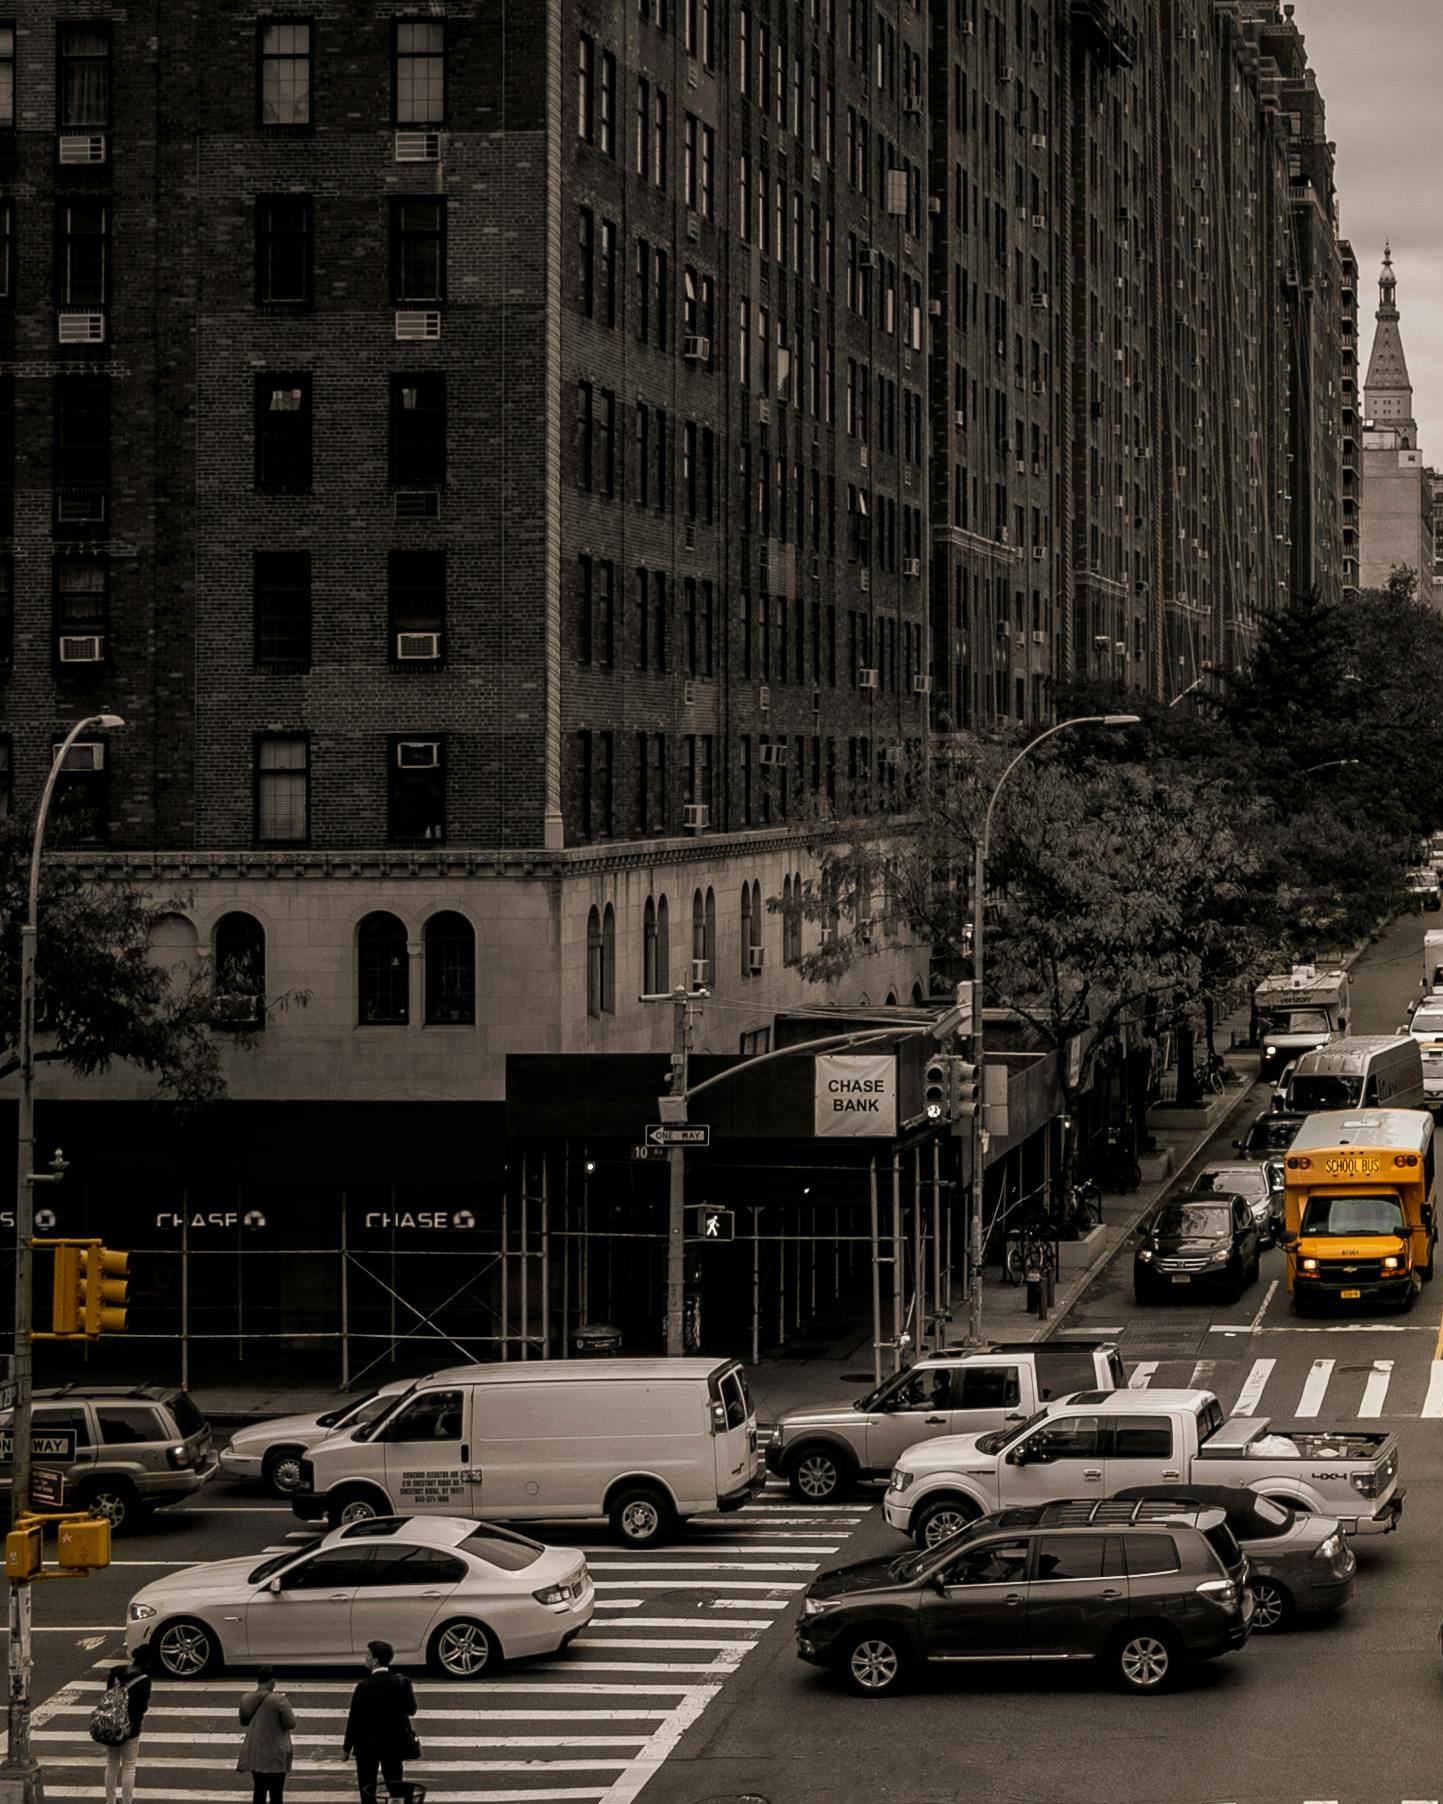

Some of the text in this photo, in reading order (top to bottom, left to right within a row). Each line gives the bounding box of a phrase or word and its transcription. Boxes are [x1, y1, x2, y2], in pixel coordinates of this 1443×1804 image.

[828, 1080, 884, 1092] CHASE
[833, 1099, 879, 1112] BANK
[656, 1131, 700, 1139] ONE WAY
[635, 1146, 648, 1158] 10
[1326, 1159, 1379, 1173] SCHOOL BUS
[365, 1211, 449, 1228] CHASE
[33, 1440, 62, 1451] WAY
